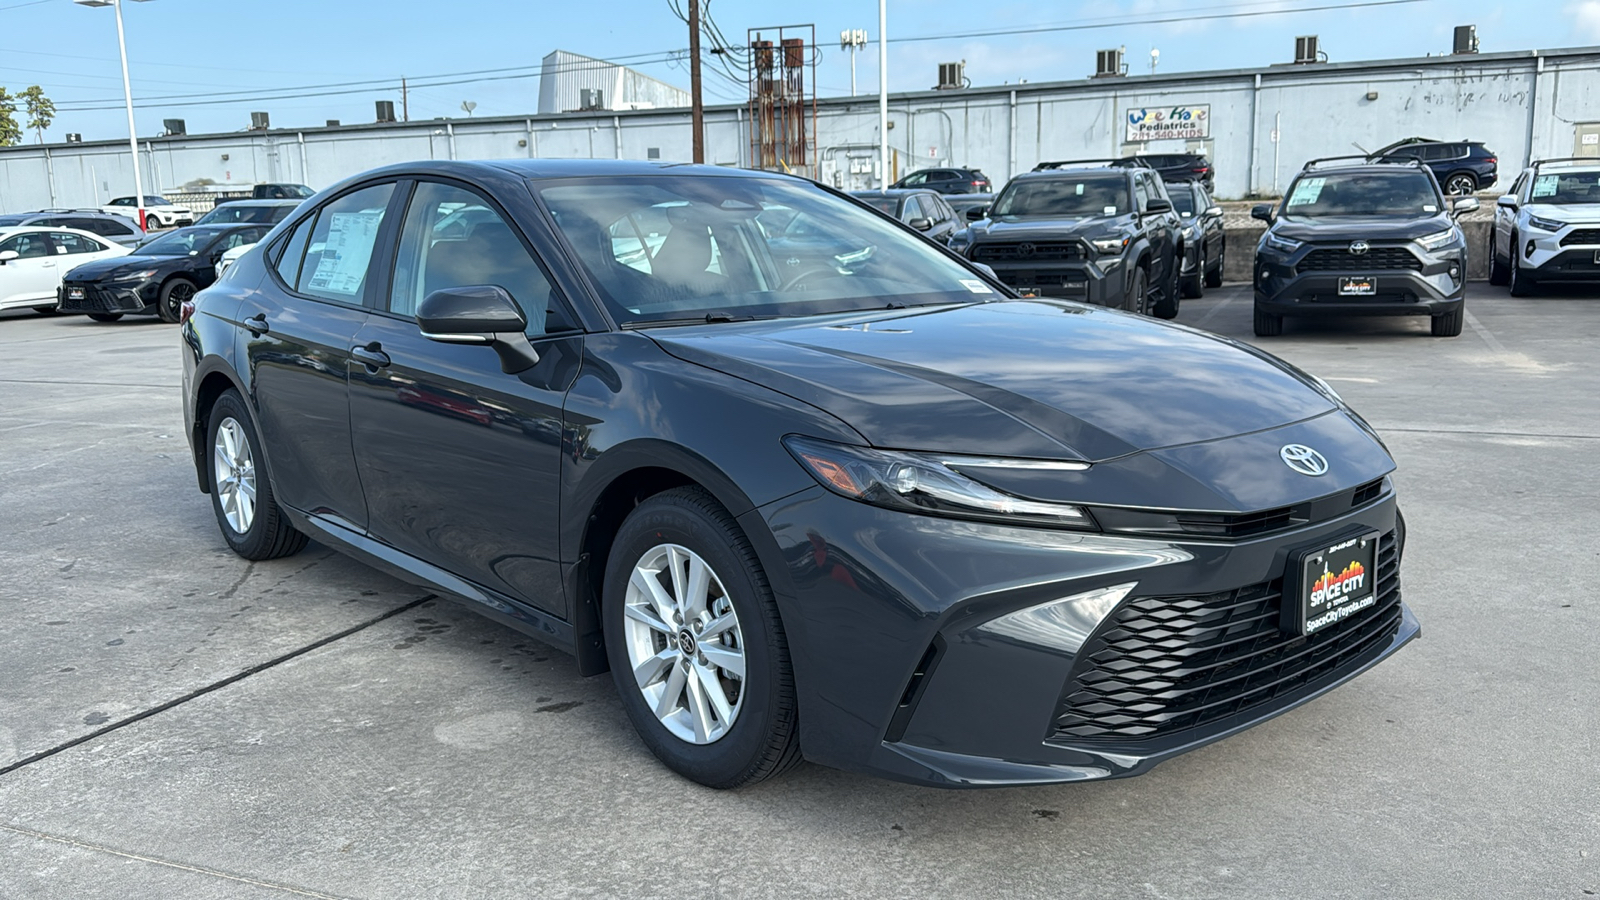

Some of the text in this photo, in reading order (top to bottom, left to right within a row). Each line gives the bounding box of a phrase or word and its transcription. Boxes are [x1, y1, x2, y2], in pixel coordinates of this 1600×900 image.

[1129, 106, 1206, 124] Wee Kare
[1132, 128, 1203, 140] 281-540-KIDS
[1139, 121, 1196, 131] Pediatrics
[1310, 573, 1365, 607] SPACE CITY
[1306, 595, 1374, 632] SpaceCityToyota.com
